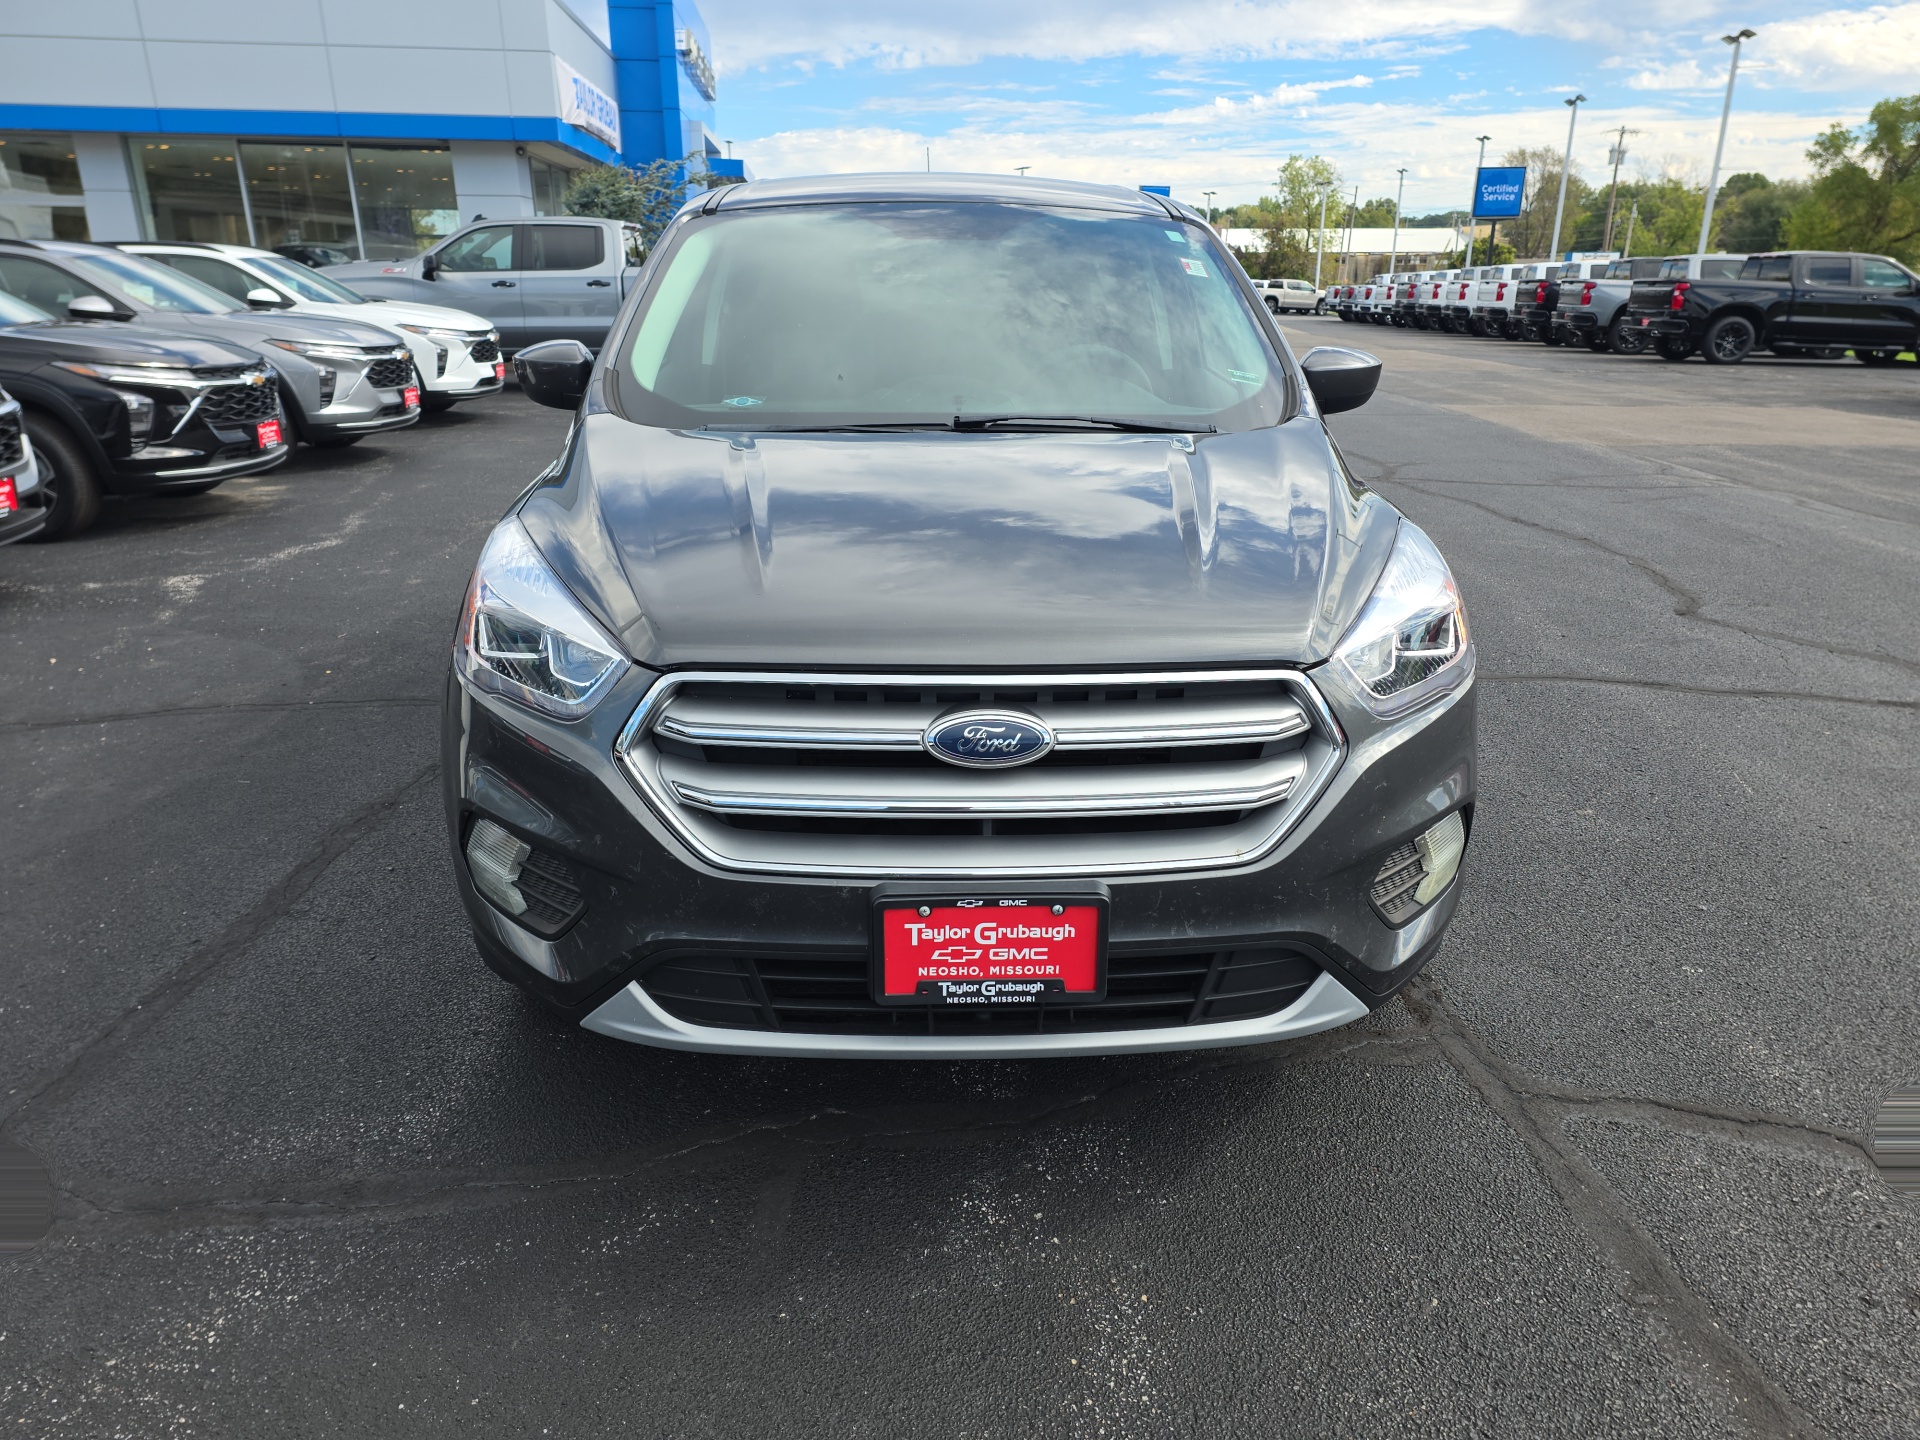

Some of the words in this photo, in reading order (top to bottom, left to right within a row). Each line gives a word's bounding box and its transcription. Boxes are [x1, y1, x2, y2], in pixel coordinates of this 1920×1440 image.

[1482, 184, 1519, 192] Certified
[1483, 193, 1515, 201] Service
[957, 725, 1022, 753] Ford
[999, 899, 1028, 907] GMC
[904, 923, 971, 946] Taylor
[974, 922, 1076, 945] Grubaugh
[989, 947, 1049, 961] GMC
[918, 966, 984, 977] NEOSHO,
[989, 965, 1060, 976] MISSOURI
[938, 981, 980, 997] Taylor
[981, 981, 1045, 996] Grubaugh
[946, 996, 988, 1004] NEOSHO,
[991, 995, 1036, 1003] MISSOURI
